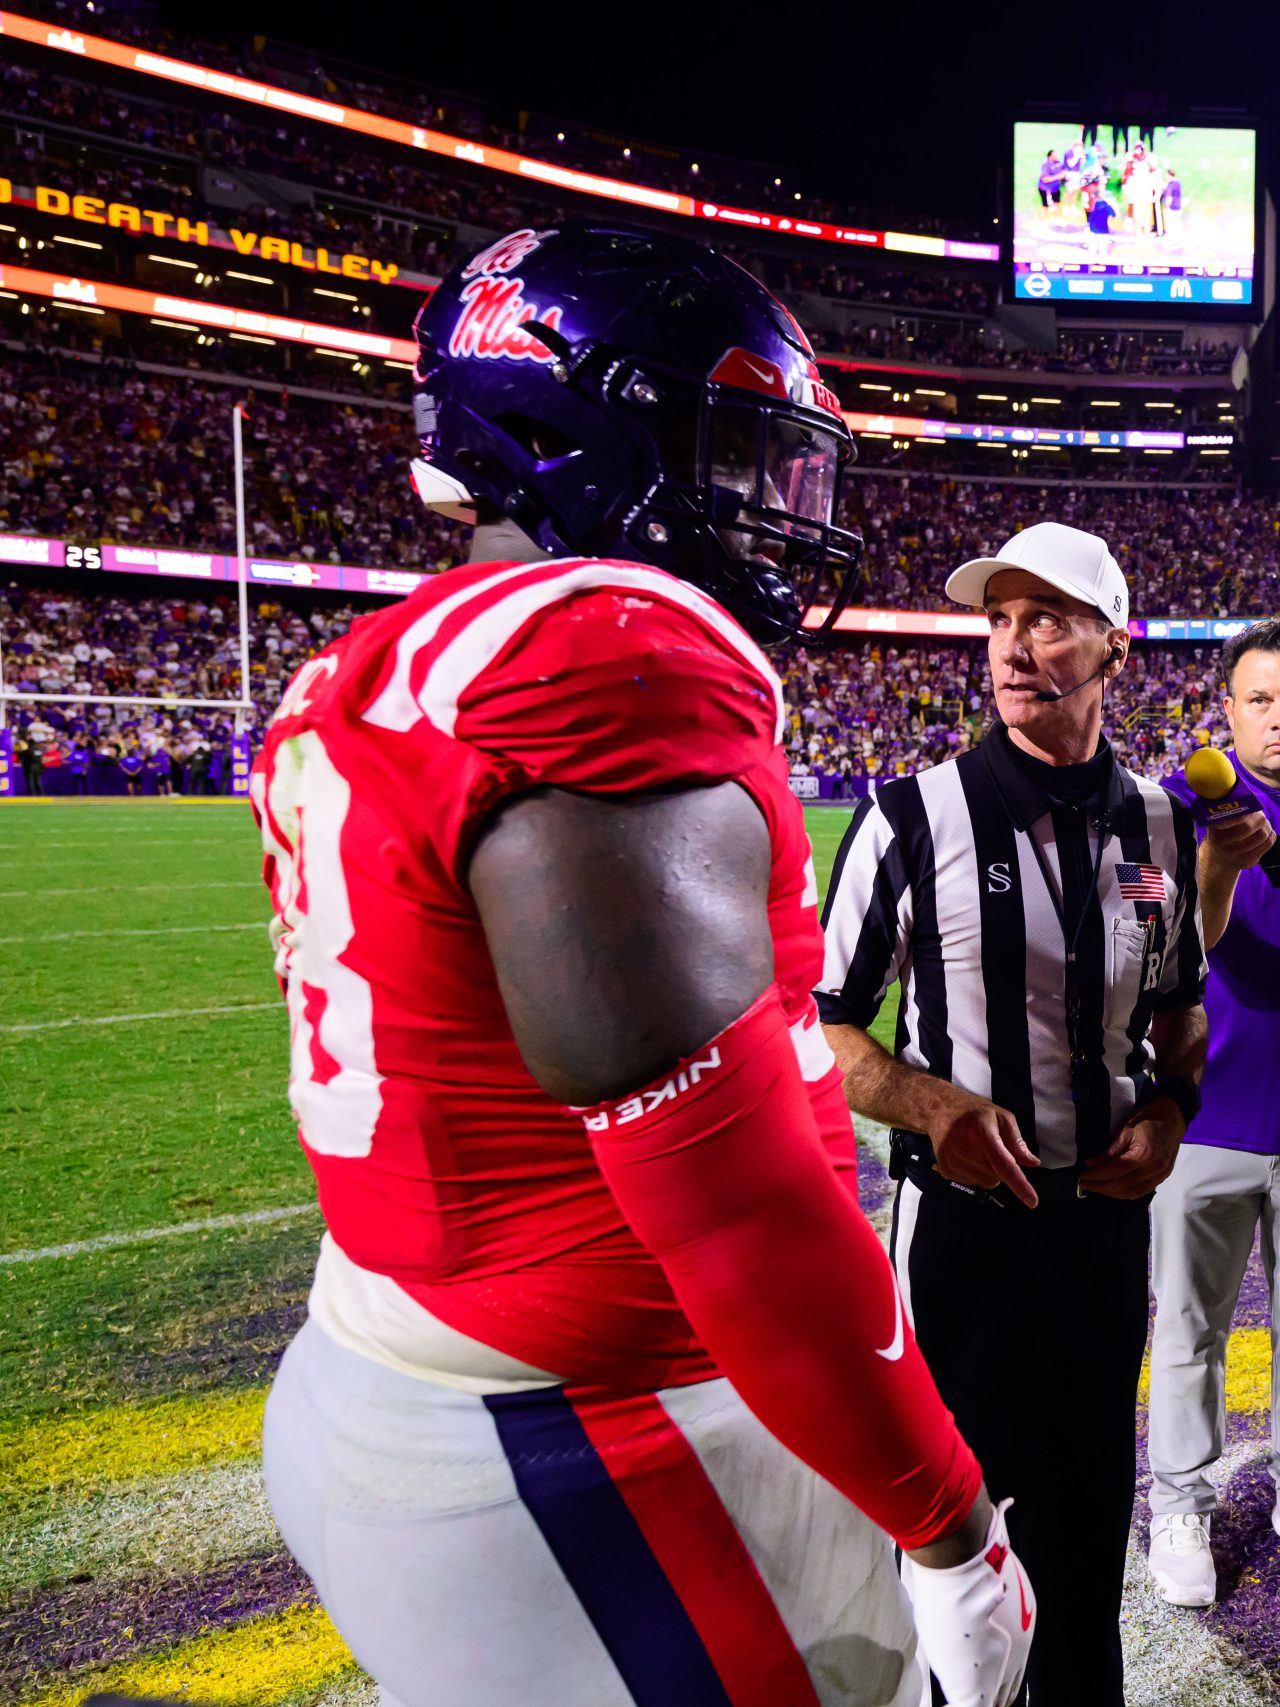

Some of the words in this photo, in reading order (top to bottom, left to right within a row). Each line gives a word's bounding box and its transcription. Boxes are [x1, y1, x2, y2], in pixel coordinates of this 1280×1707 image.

[36, 185, 209, 246] DEATH
[230, 229, 399, 285] VALLEY
[449, 275, 564, 364] Miss
[66, 546, 101, 569] 25
[1113, 595, 1122, 612] S
[1208, 800, 1240, 815] LSU
[988, 862, 1012, 893] S
[1143, 951, 1161, 991] R
[615, 1046, 721, 1126] NIKE
